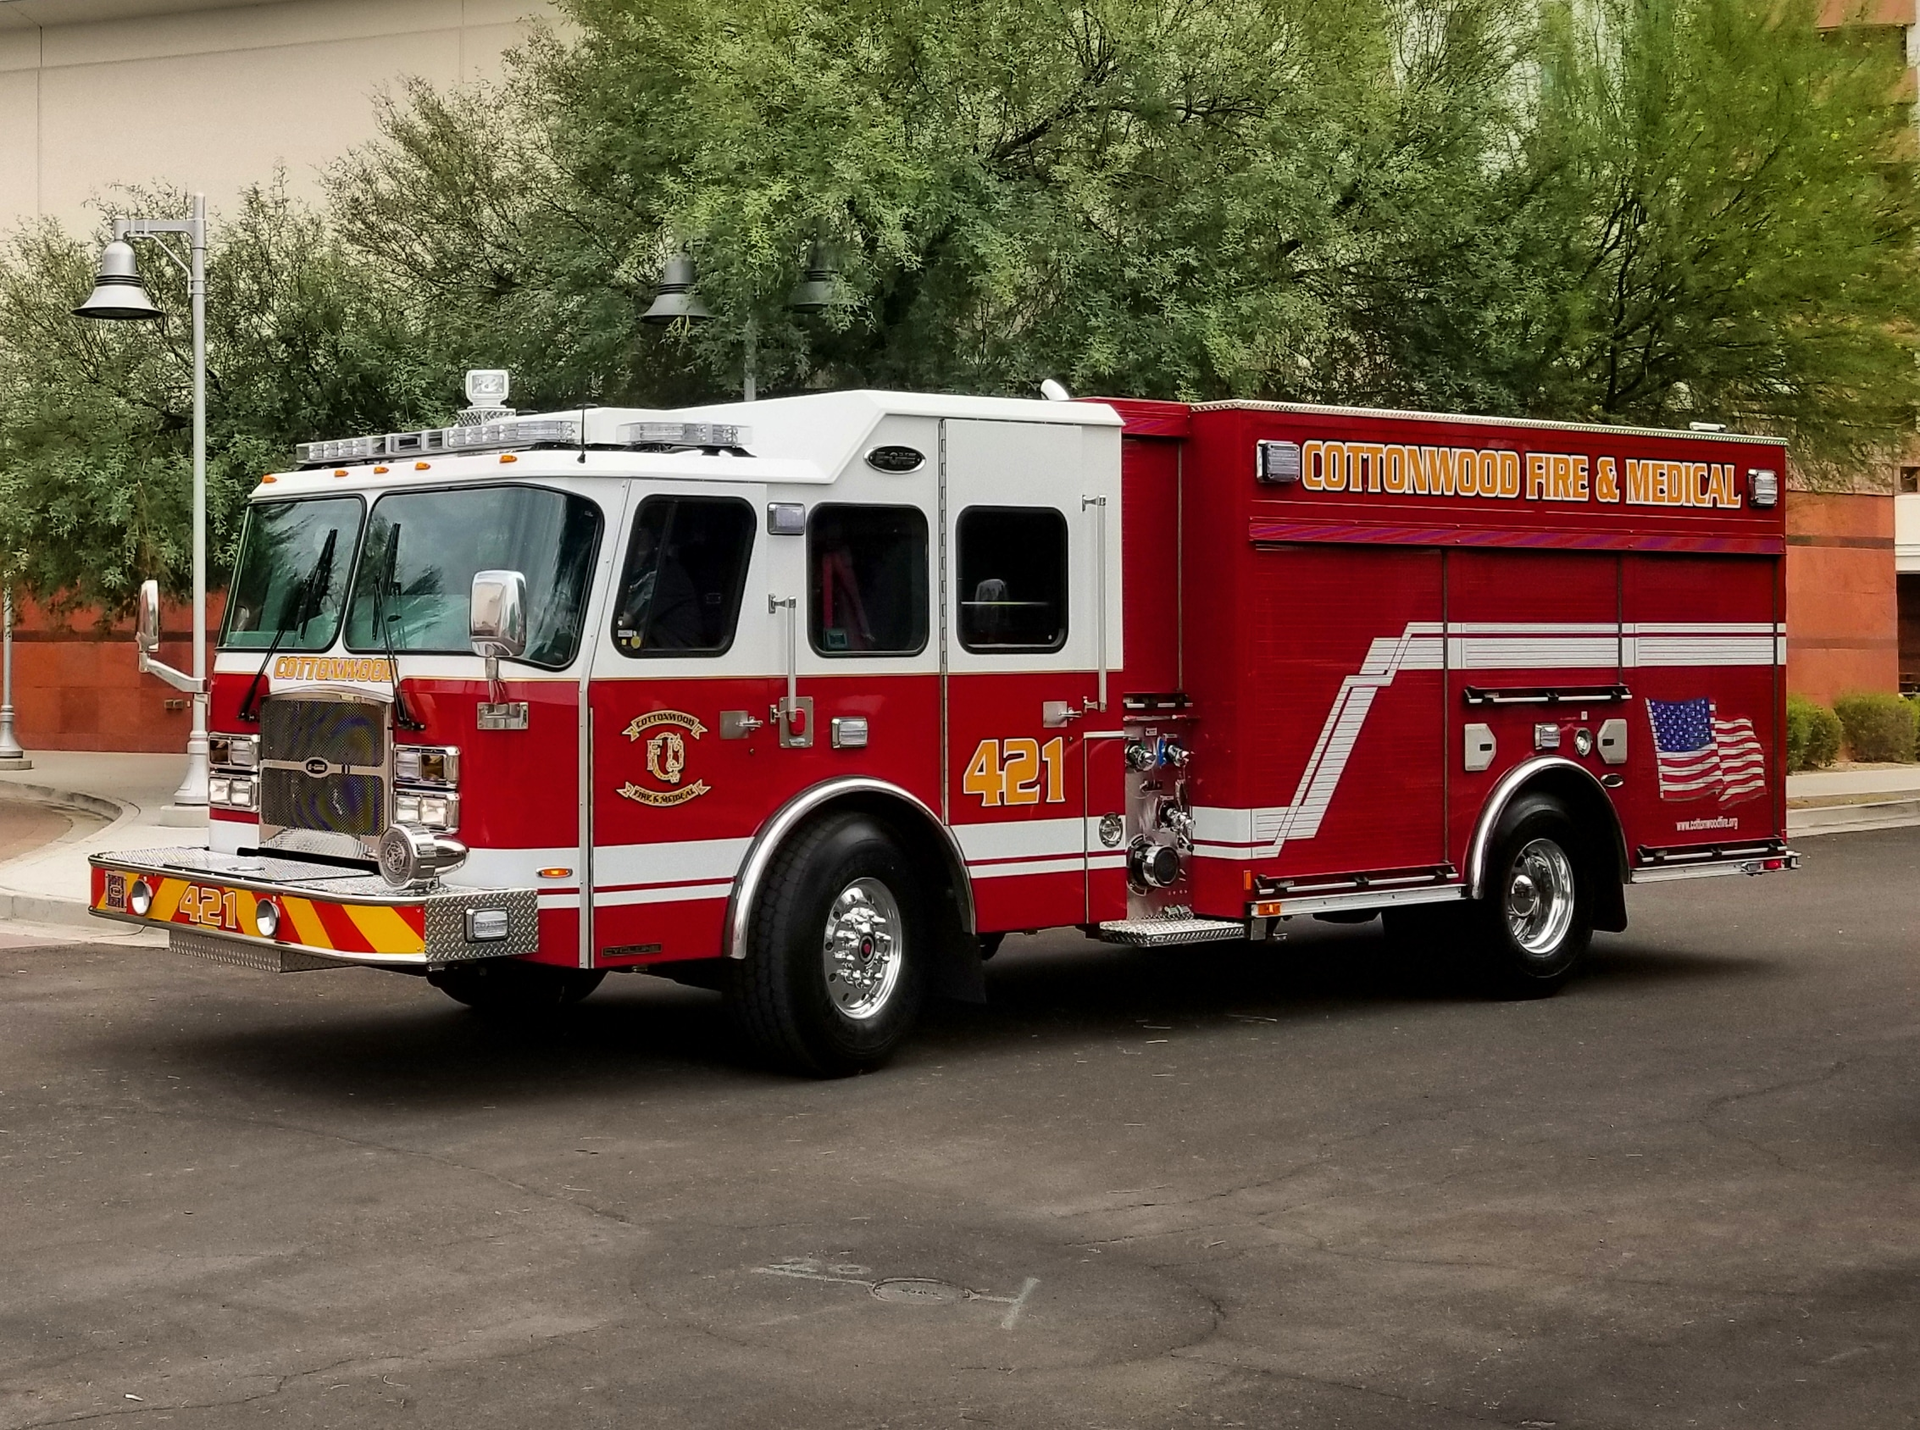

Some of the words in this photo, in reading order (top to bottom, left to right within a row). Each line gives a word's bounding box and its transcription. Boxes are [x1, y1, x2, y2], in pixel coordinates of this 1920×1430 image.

[1302, 440, 1520, 497] COTTONWOOD
[1526, 453, 1590, 501] FIRE
[1595, 456, 1621, 504] &
[1625, 458, 1743, 510] MEDICAL
[635, 712, 695, 729] COTTONWOOD
[963, 736, 1066, 807] 421
[633, 788, 652, 802] FIRE
[179, 885, 237, 930] 421
